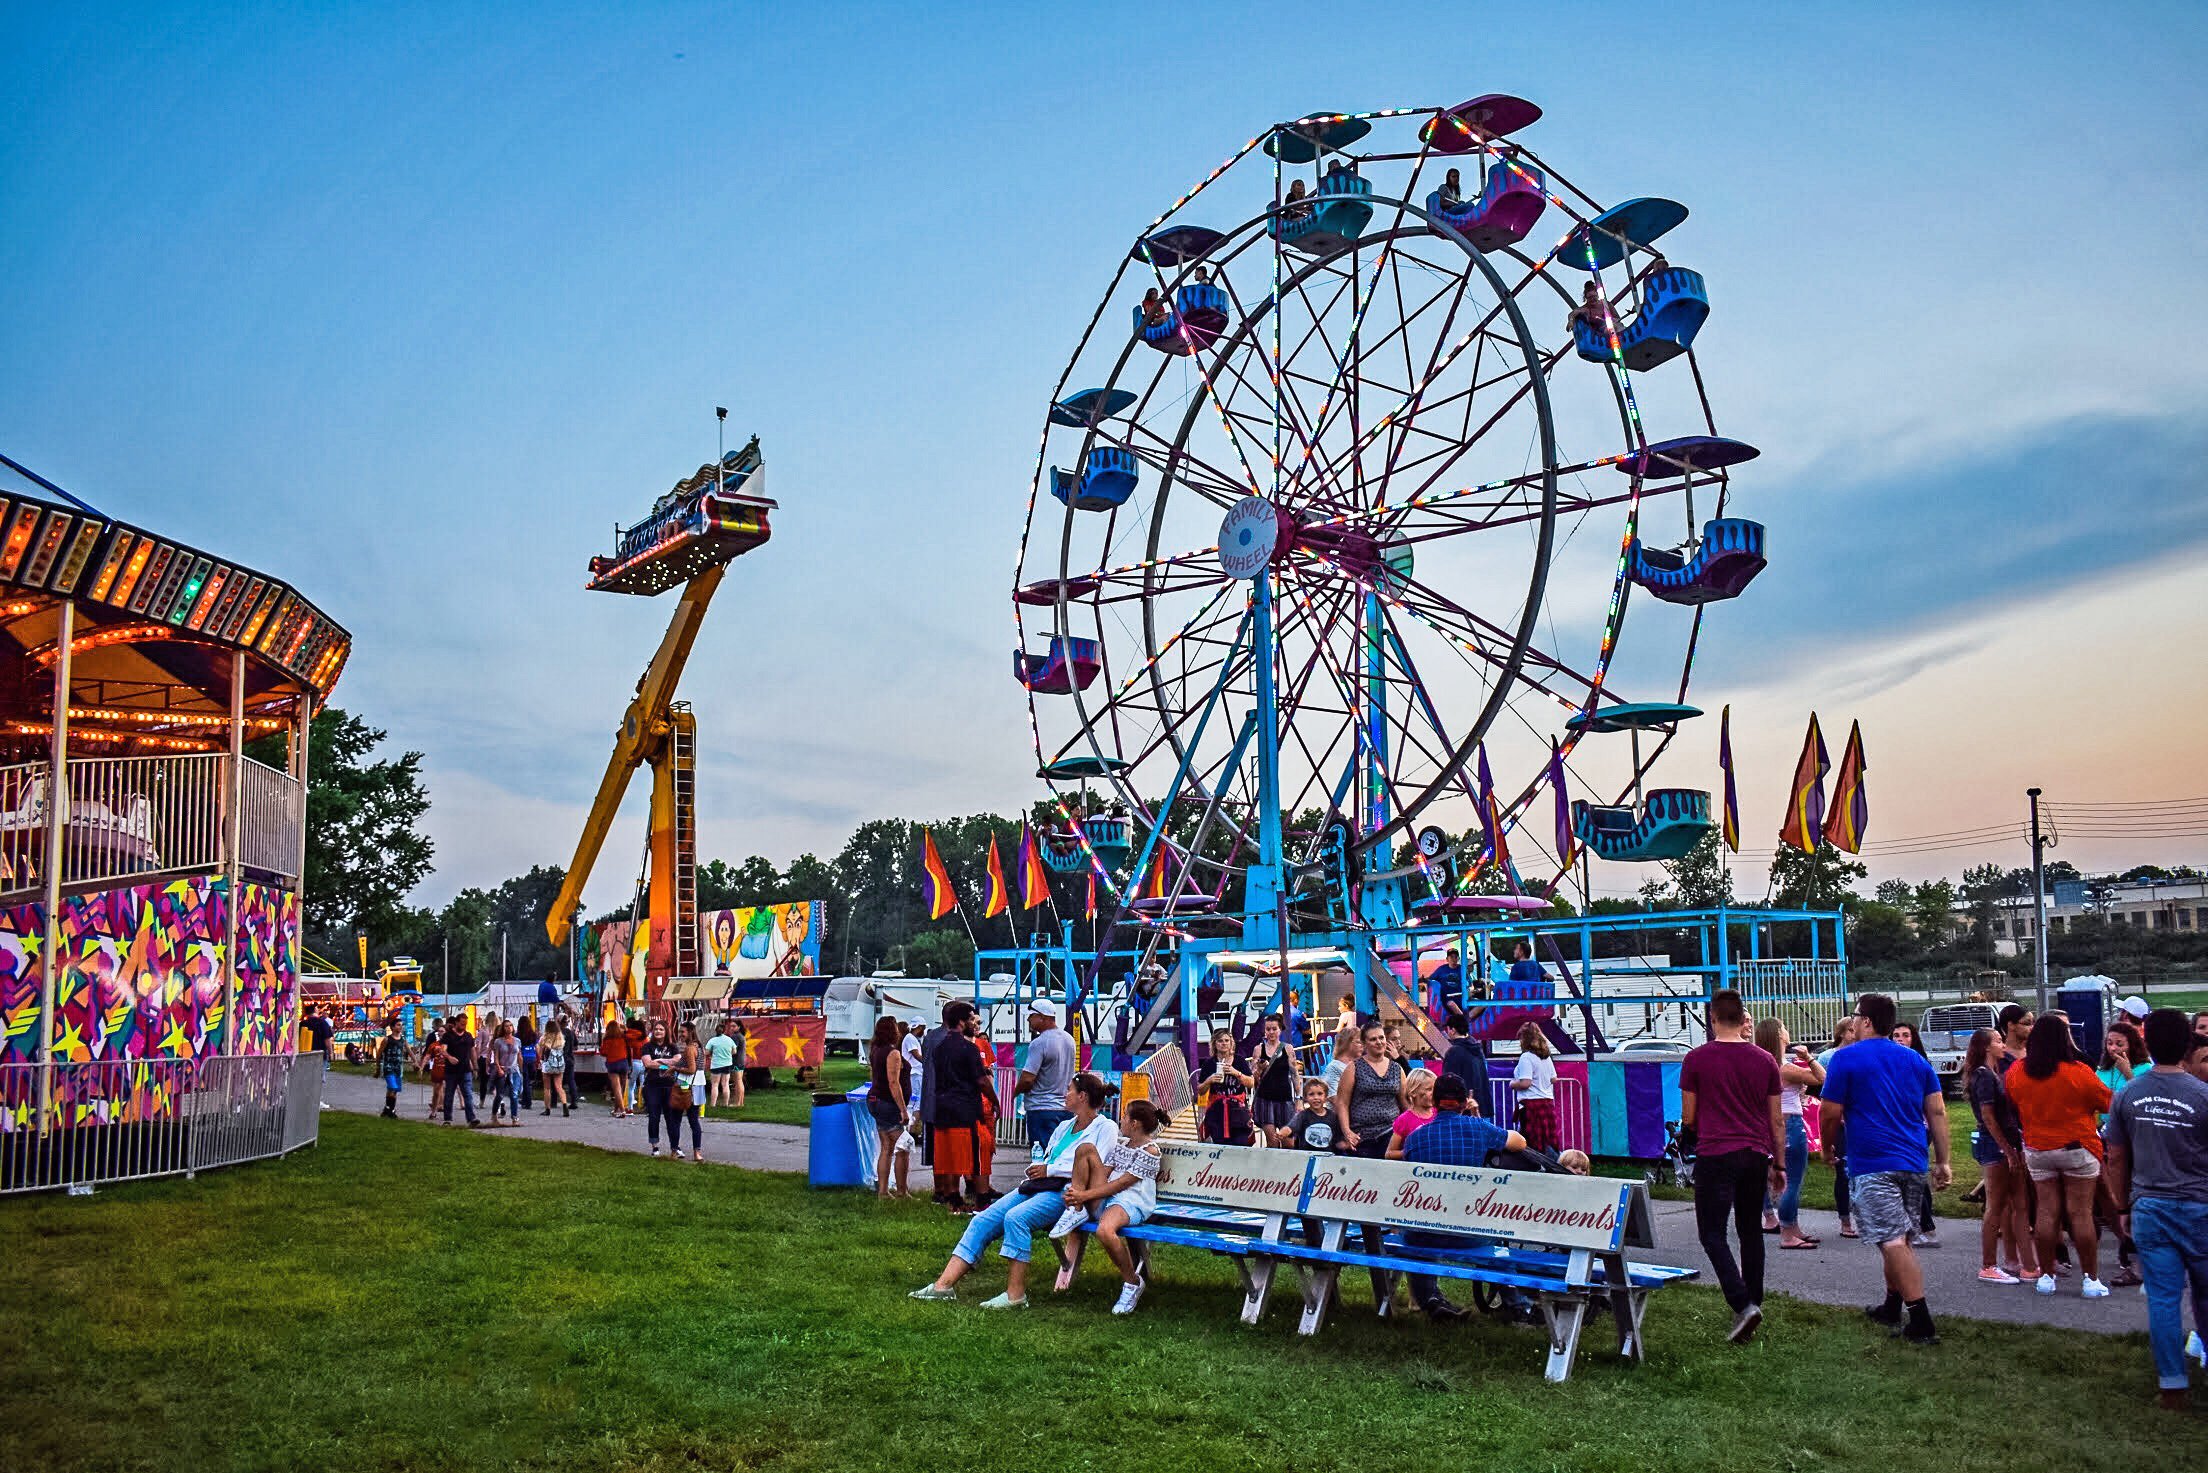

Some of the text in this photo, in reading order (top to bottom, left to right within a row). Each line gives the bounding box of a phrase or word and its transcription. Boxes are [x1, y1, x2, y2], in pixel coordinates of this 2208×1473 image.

[1222, 501, 1275, 535] FAMILY
[1223, 544, 1271, 571] WHEEL
[994, 1027, 1023, 1035] Marathn
[2132, 1096, 2195, 1114] World Class Quality
[1160, 1147, 1224, 1160] urtesy of
[1156, 1162, 1302, 1197] os. Amusements
[1412, 1165, 1512, 1185] Courtesy of
[1311, 1172, 1615, 1231] Burton Bros. Amusements
[1384, 1216, 1515, 1237] www.burtonbrothersamusements.com
